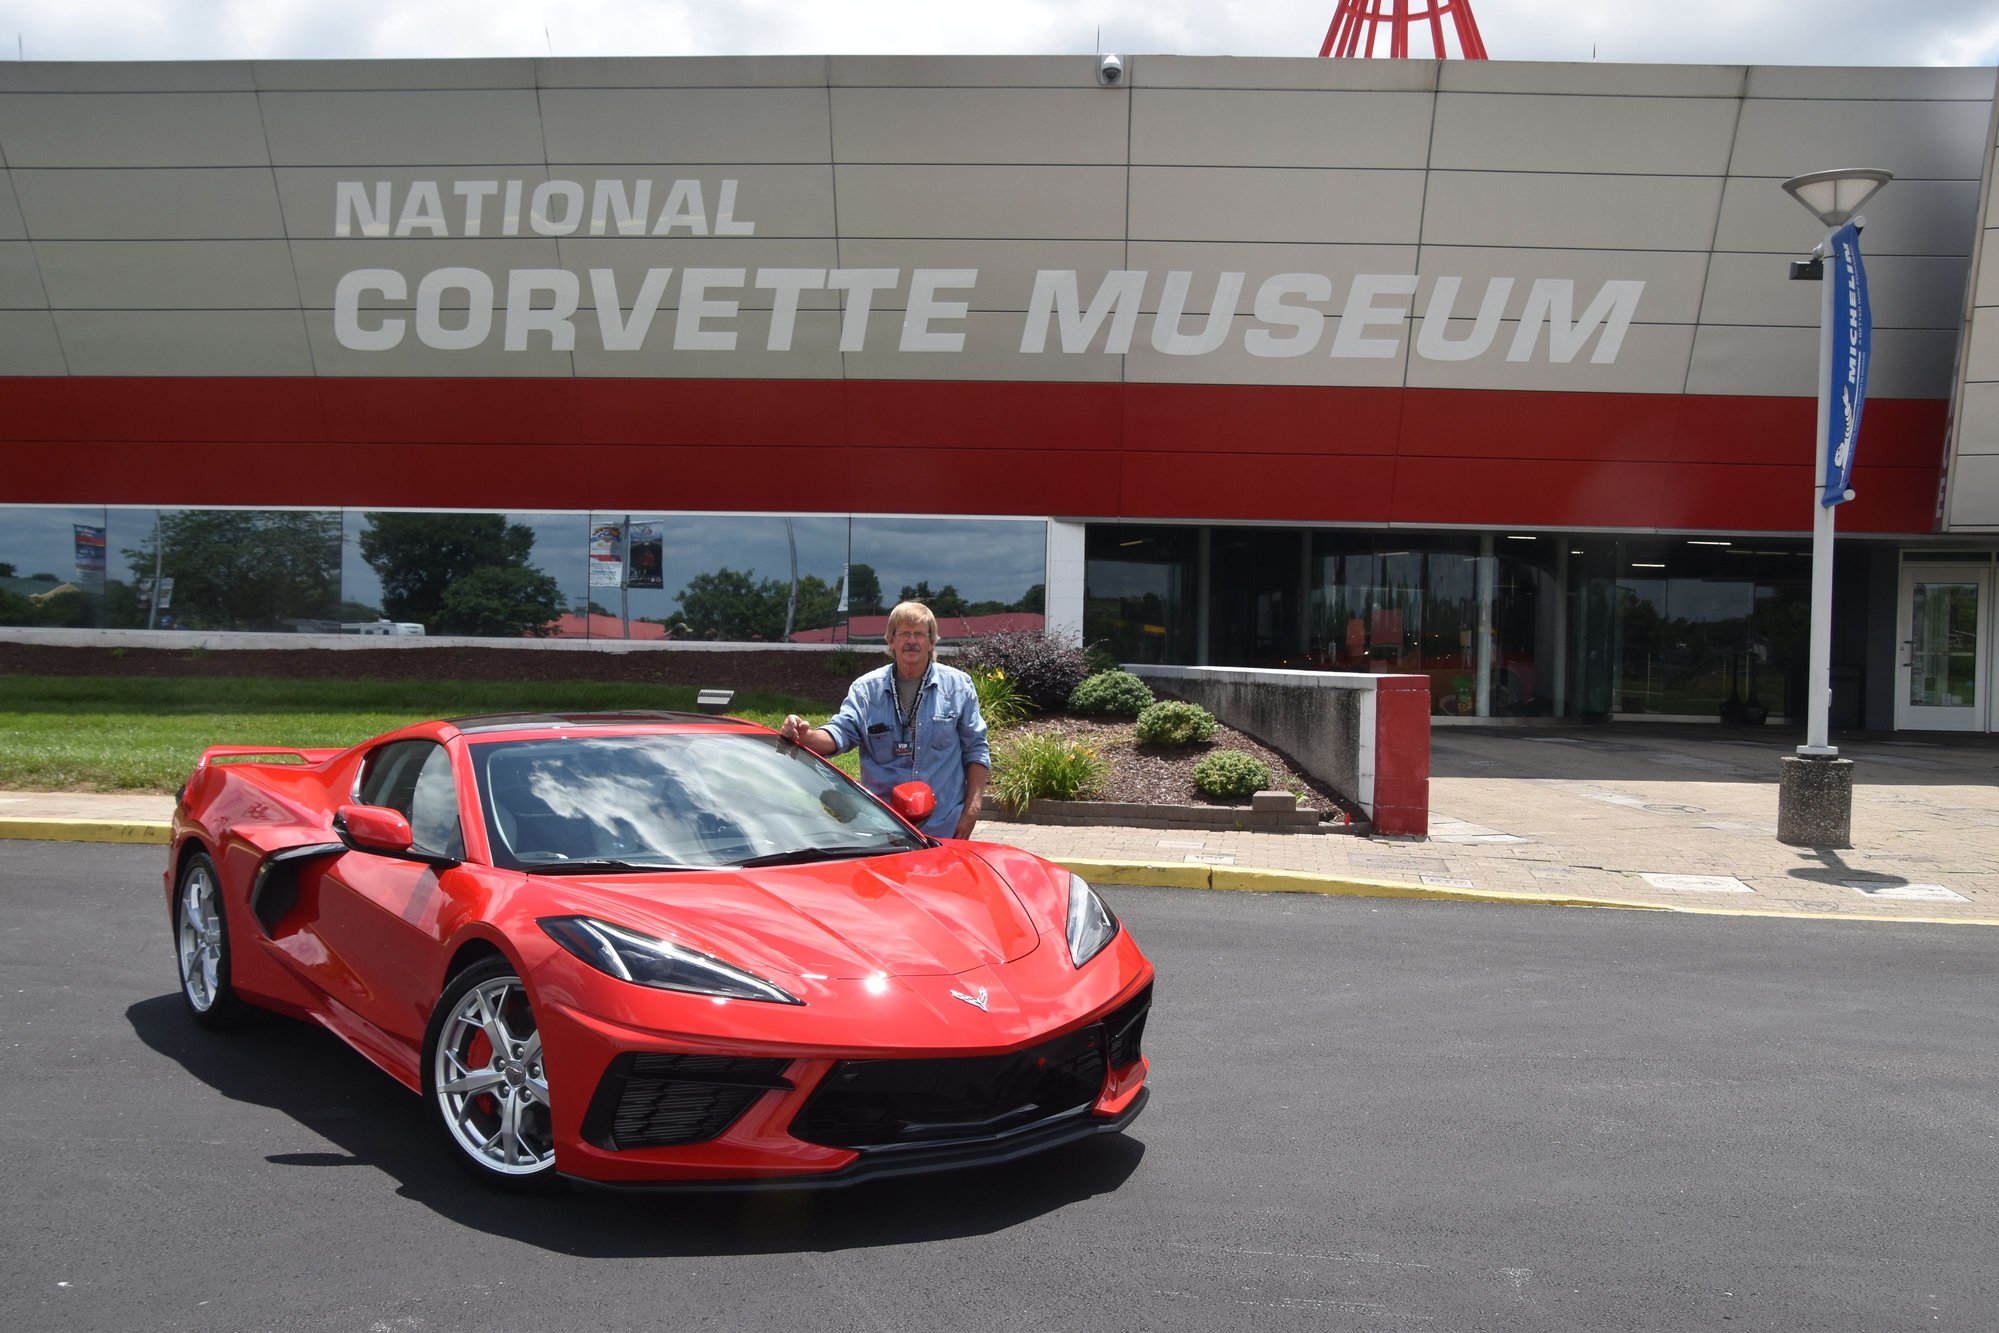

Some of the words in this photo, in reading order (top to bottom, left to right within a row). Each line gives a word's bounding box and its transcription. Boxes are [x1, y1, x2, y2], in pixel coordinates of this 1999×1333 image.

[335, 179, 755, 237] NATIONAL
[334, 267, 979, 352] CORVETTE
[1019, 270, 1647, 364] MUSEUM
[1842, 242, 1857, 384] MICHELIN
